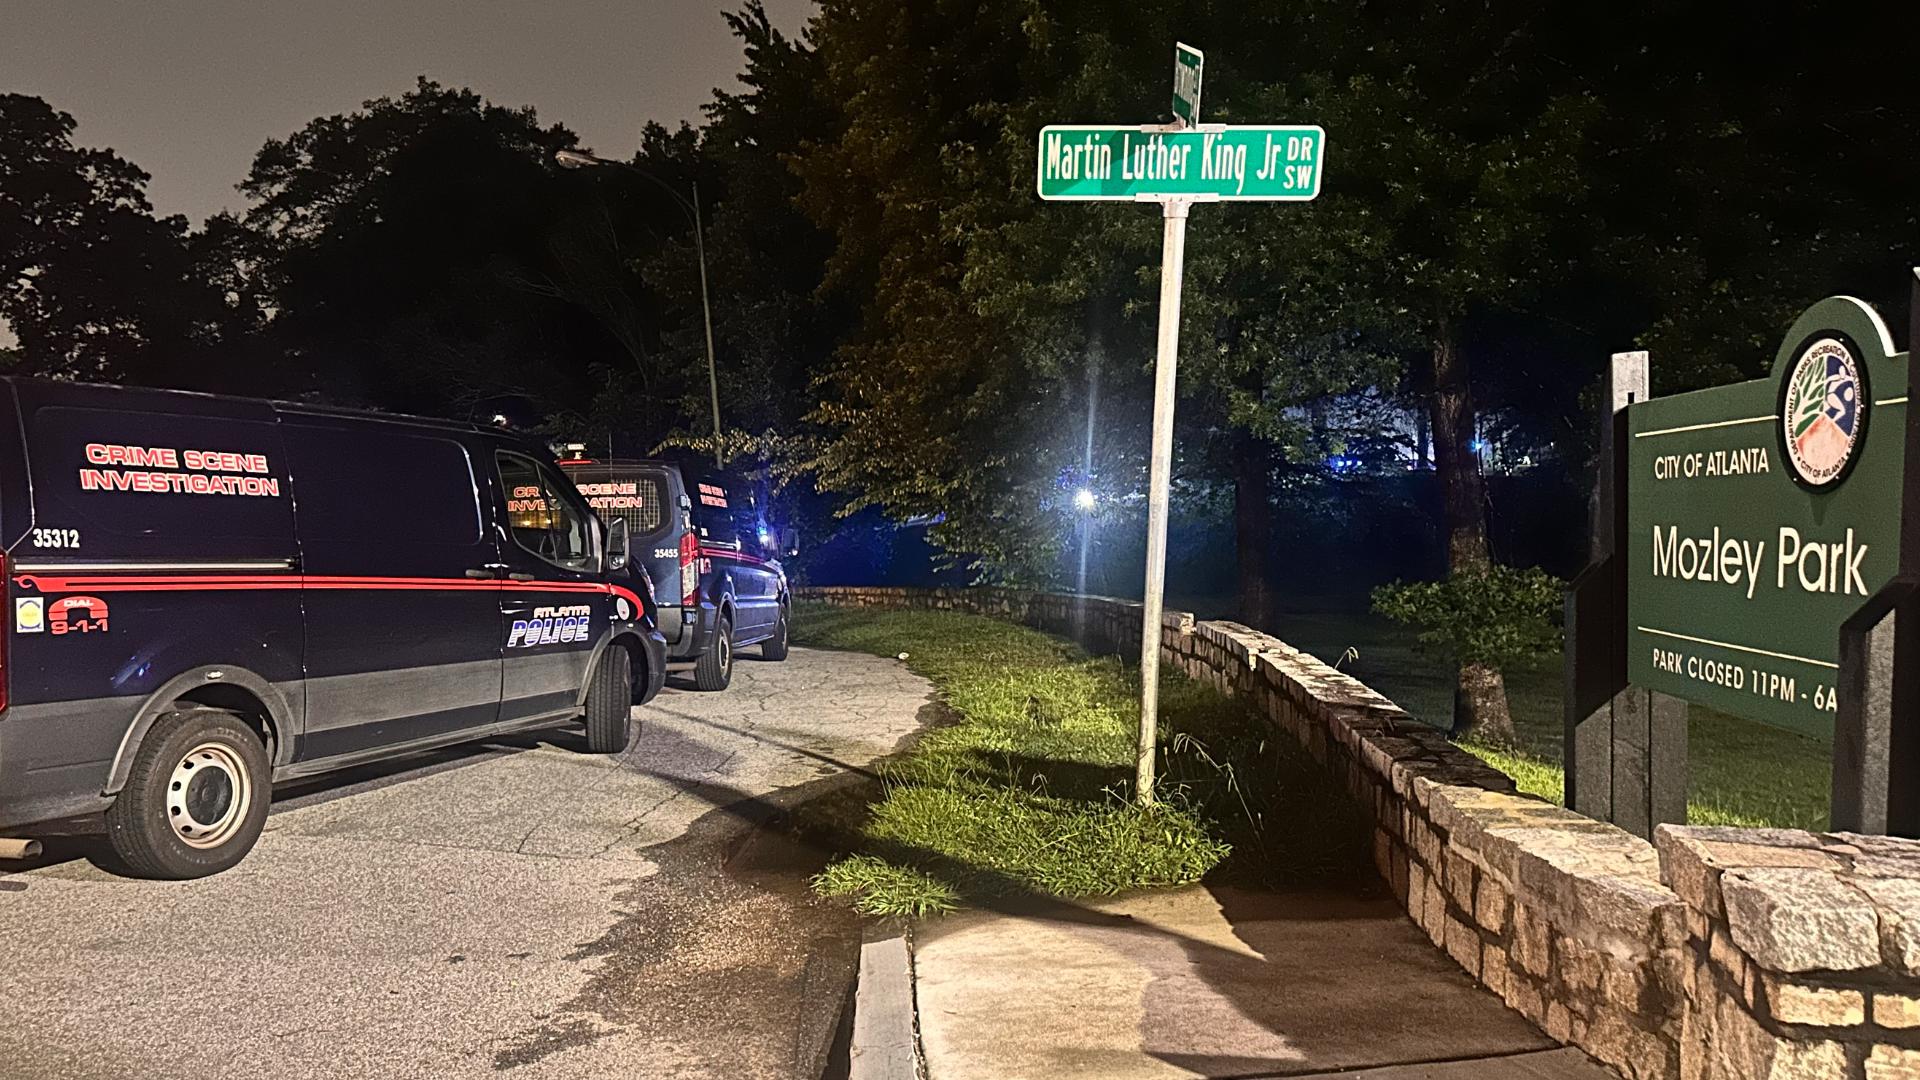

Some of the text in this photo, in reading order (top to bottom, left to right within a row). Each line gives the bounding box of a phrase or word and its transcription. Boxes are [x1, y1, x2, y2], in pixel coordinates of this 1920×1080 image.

[1287, 136, 1313, 161] DR
[1047, 133, 1282, 195] Martin Luther King Jr
[1283, 165, 1313, 190] SW
[86, 443, 269, 473] CRIME SCENE
[1654, 448, 1770, 480] CITY OF ATLANTA
[1800, 456, 1846, 478] CITY OF ATLANTA
[79, 469, 280, 497] INVESTIGATION
[33, 528, 80, 548] 35312
[654, 549, 679, 559] 35455
[1653, 525, 1869, 600] Mozley Park
[533, 605, 591, 618] ATLANTA
[51, 619, 108, 635] 9-1-1
[507, 616, 590, 647] POLICE
[1653, 648, 1683, 675] PARK
[1688, 656, 1745, 690] CLOSED
[1751, 670, 1795, 703] 11PM
[1814, 684, 1838, 712] 6A
